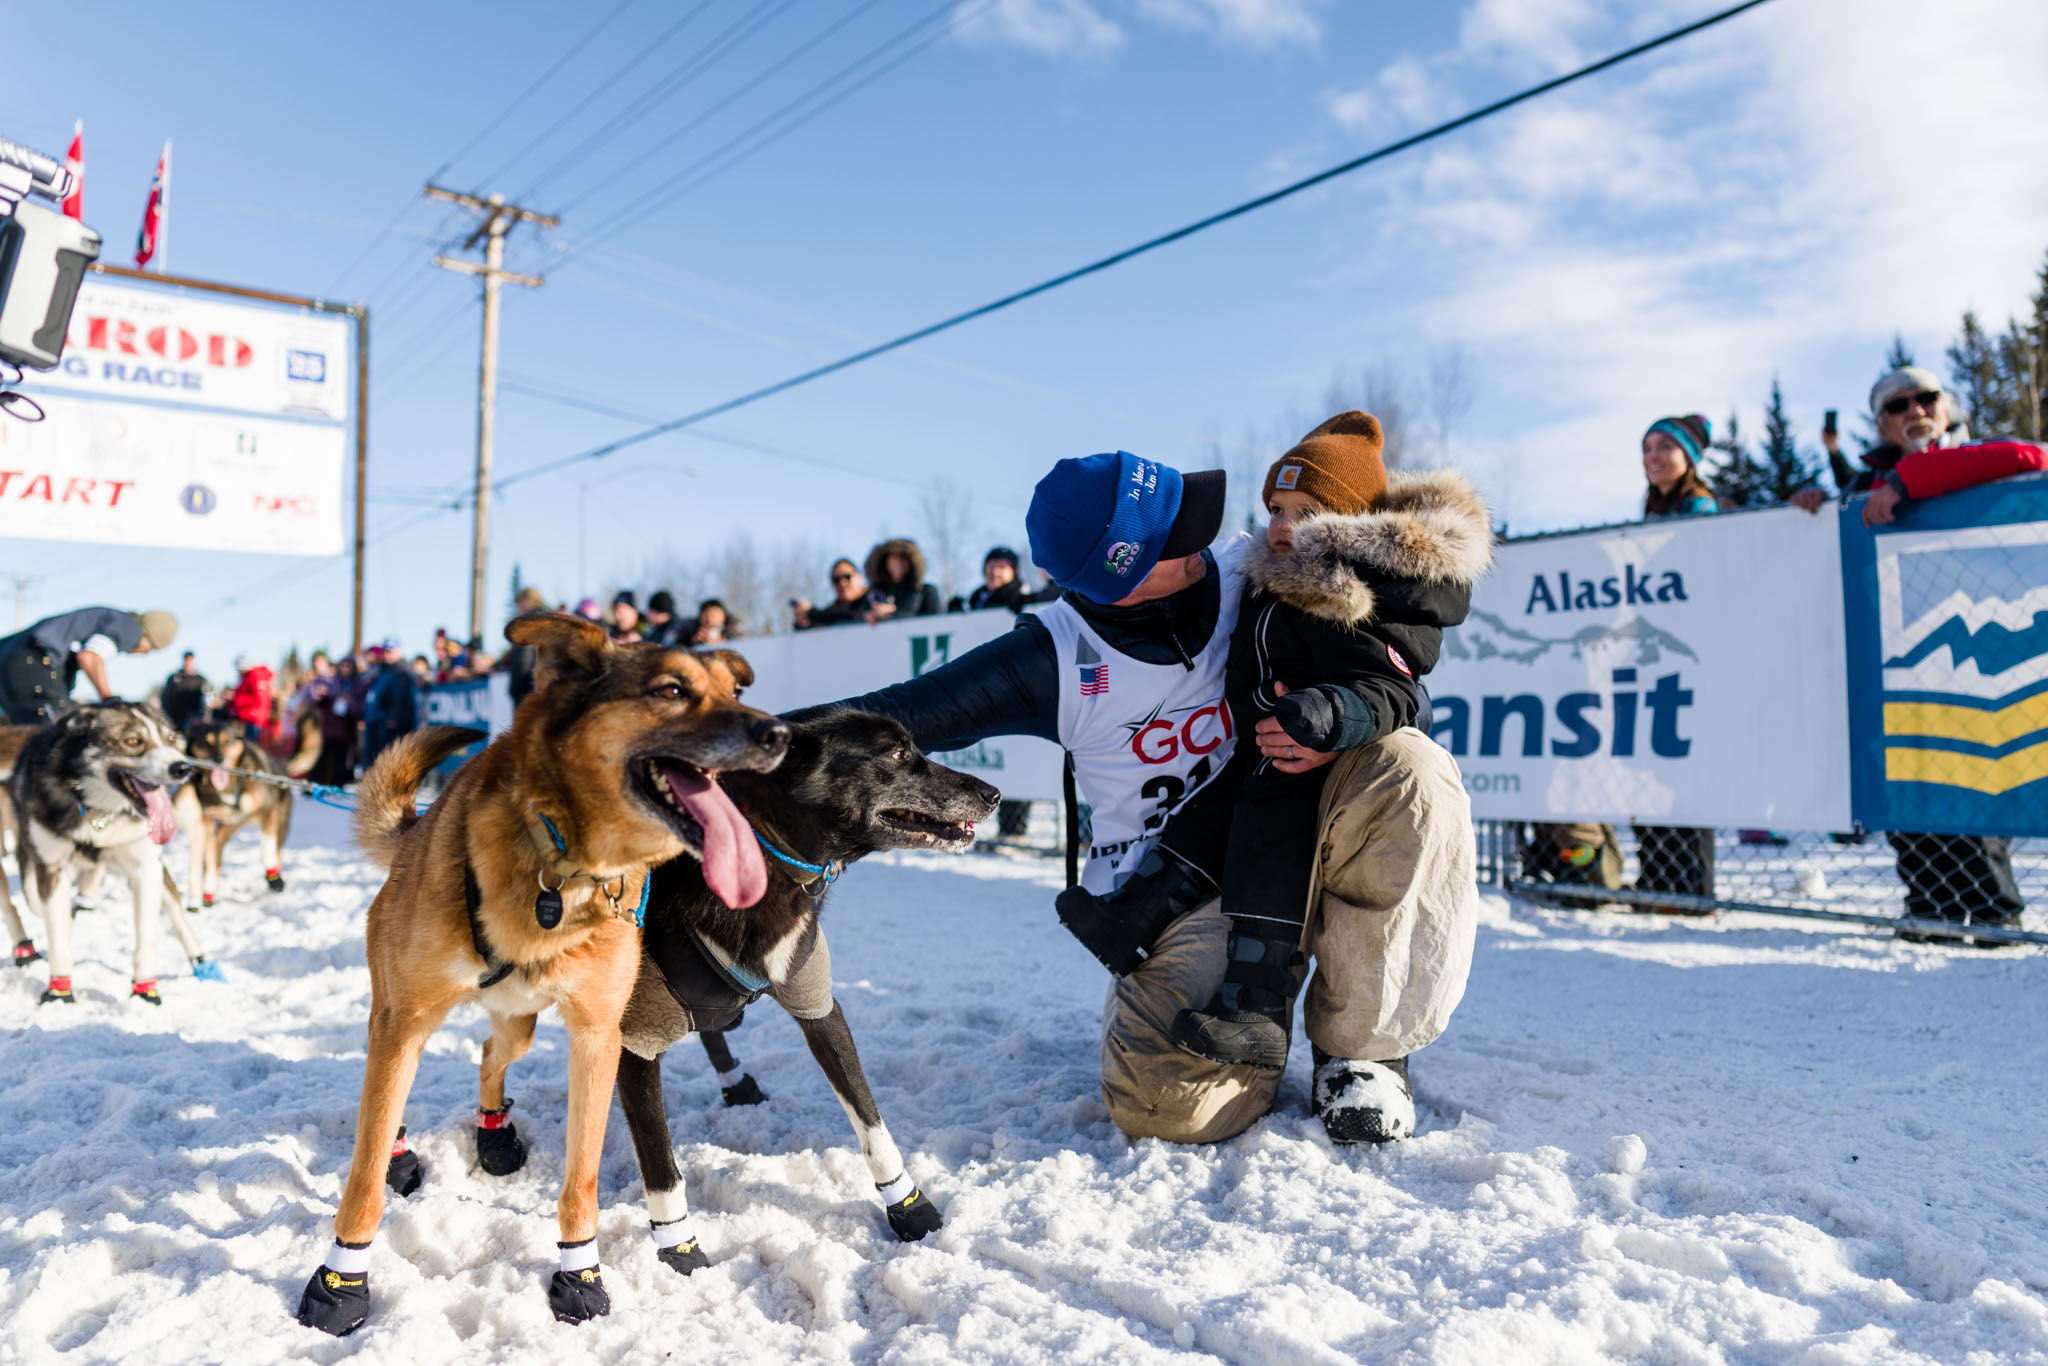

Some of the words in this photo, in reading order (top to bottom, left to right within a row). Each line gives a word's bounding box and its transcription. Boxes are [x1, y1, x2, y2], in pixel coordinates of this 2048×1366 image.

[64, 315, 254, 369] ROD
[102, 361, 203, 391] RACE
[0, 471, 135, 507] TART
[1128, 488, 1142, 501] In
[1144, 474, 1158, 494] Jim
[1525, 564, 1688, 615] Alaska
[1132, 696, 1233, 764] GCI
[1430, 668, 1694, 758] ansit
